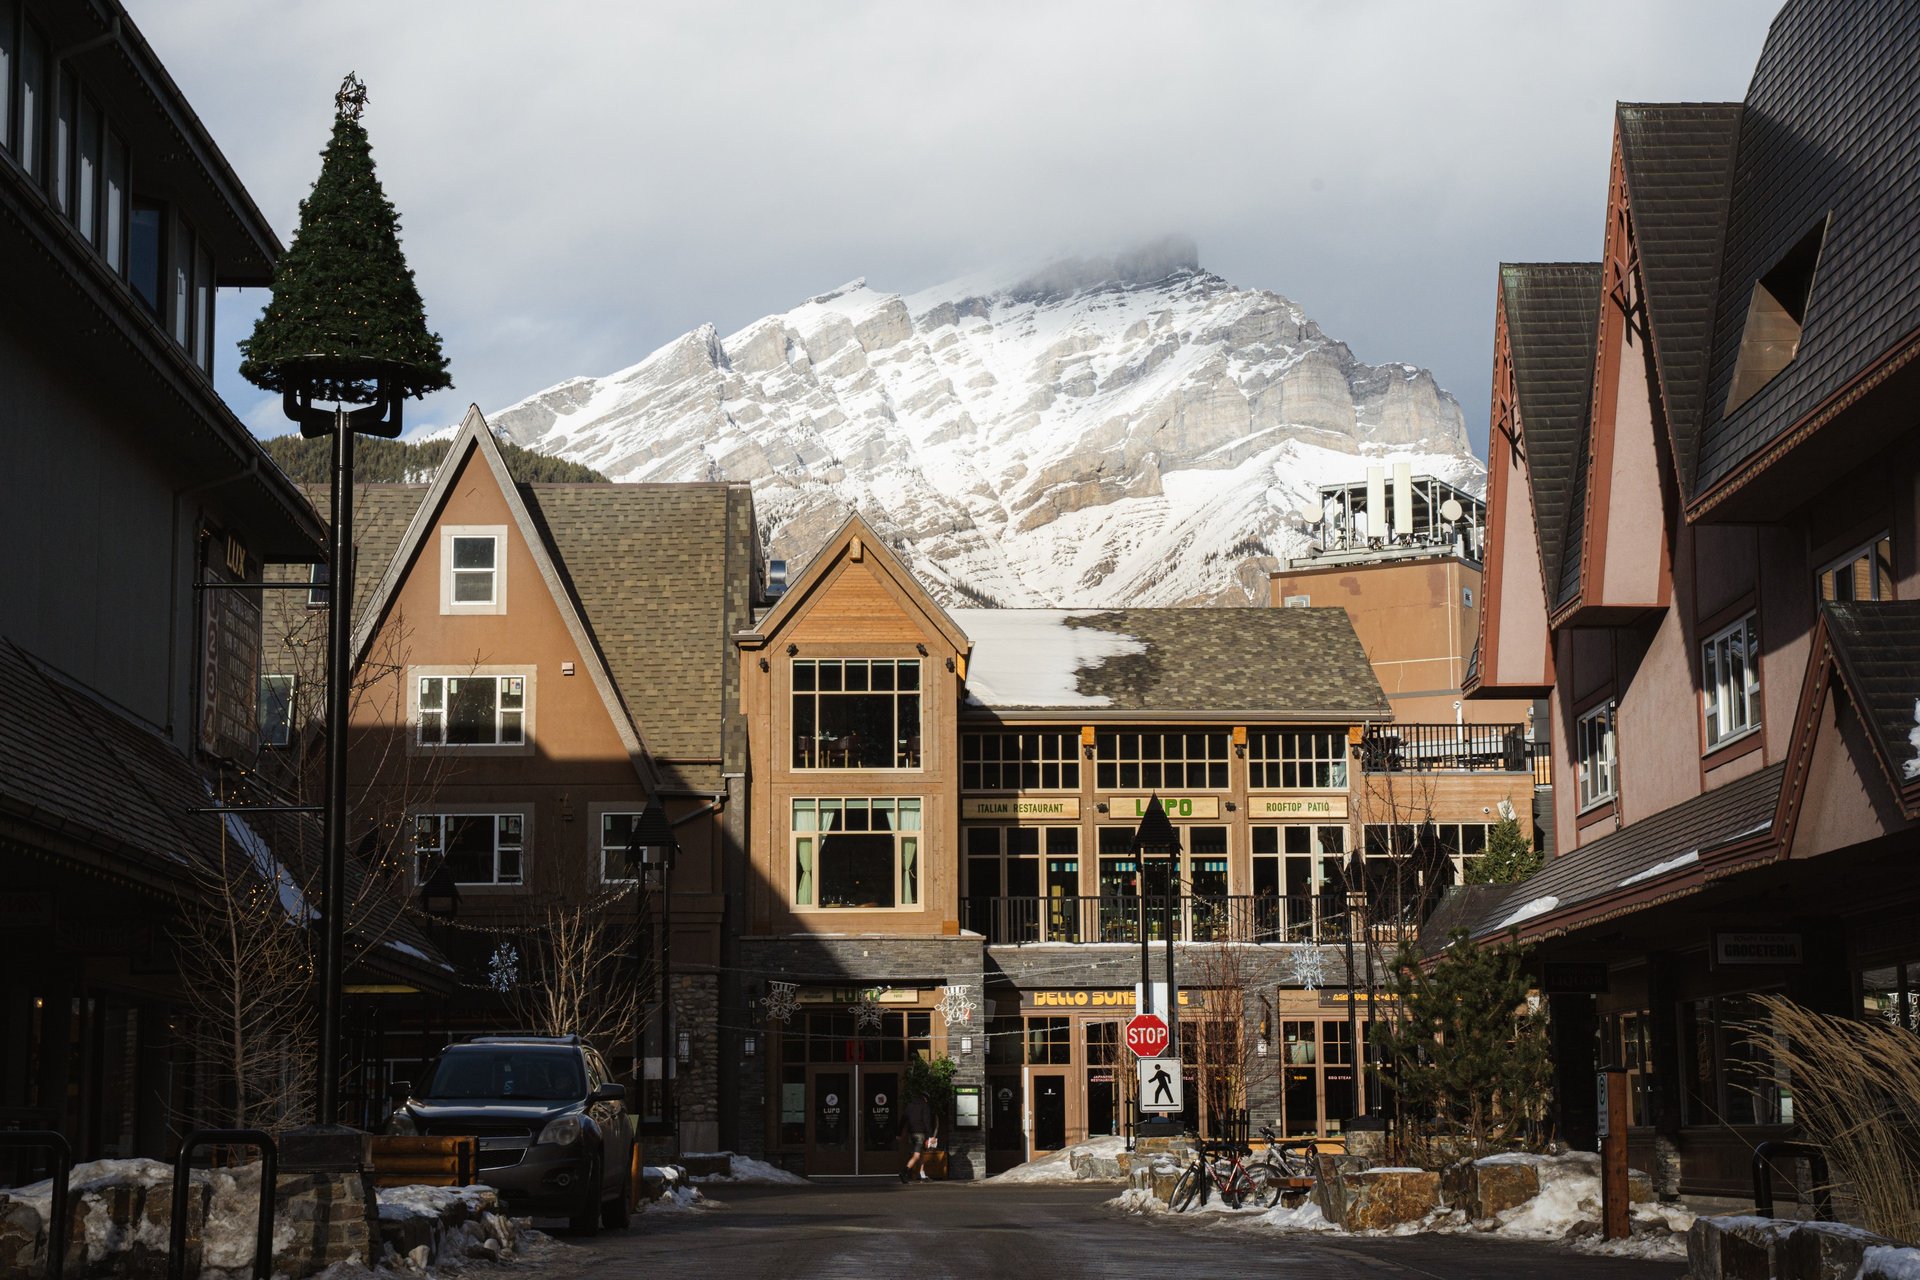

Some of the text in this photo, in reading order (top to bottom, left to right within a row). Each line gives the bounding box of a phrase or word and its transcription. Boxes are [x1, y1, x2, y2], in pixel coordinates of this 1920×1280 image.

[226, 535, 247, 580] LUX
[208, 630, 217, 654] 2
[207, 671, 216, 695] 3
[205, 712, 213, 735] 4
[977, 803, 1064, 813] ITALIAN RESTAURANT
[1135, 798, 1193, 817] LPO
[1266, 802, 1330, 812] ROOFTOP PATIO
[1724, 943, 1797, 958] GROCETERIA
[1034, 991, 1088, 1006] HELLO
[1128, 1027, 1167, 1045] STOP
